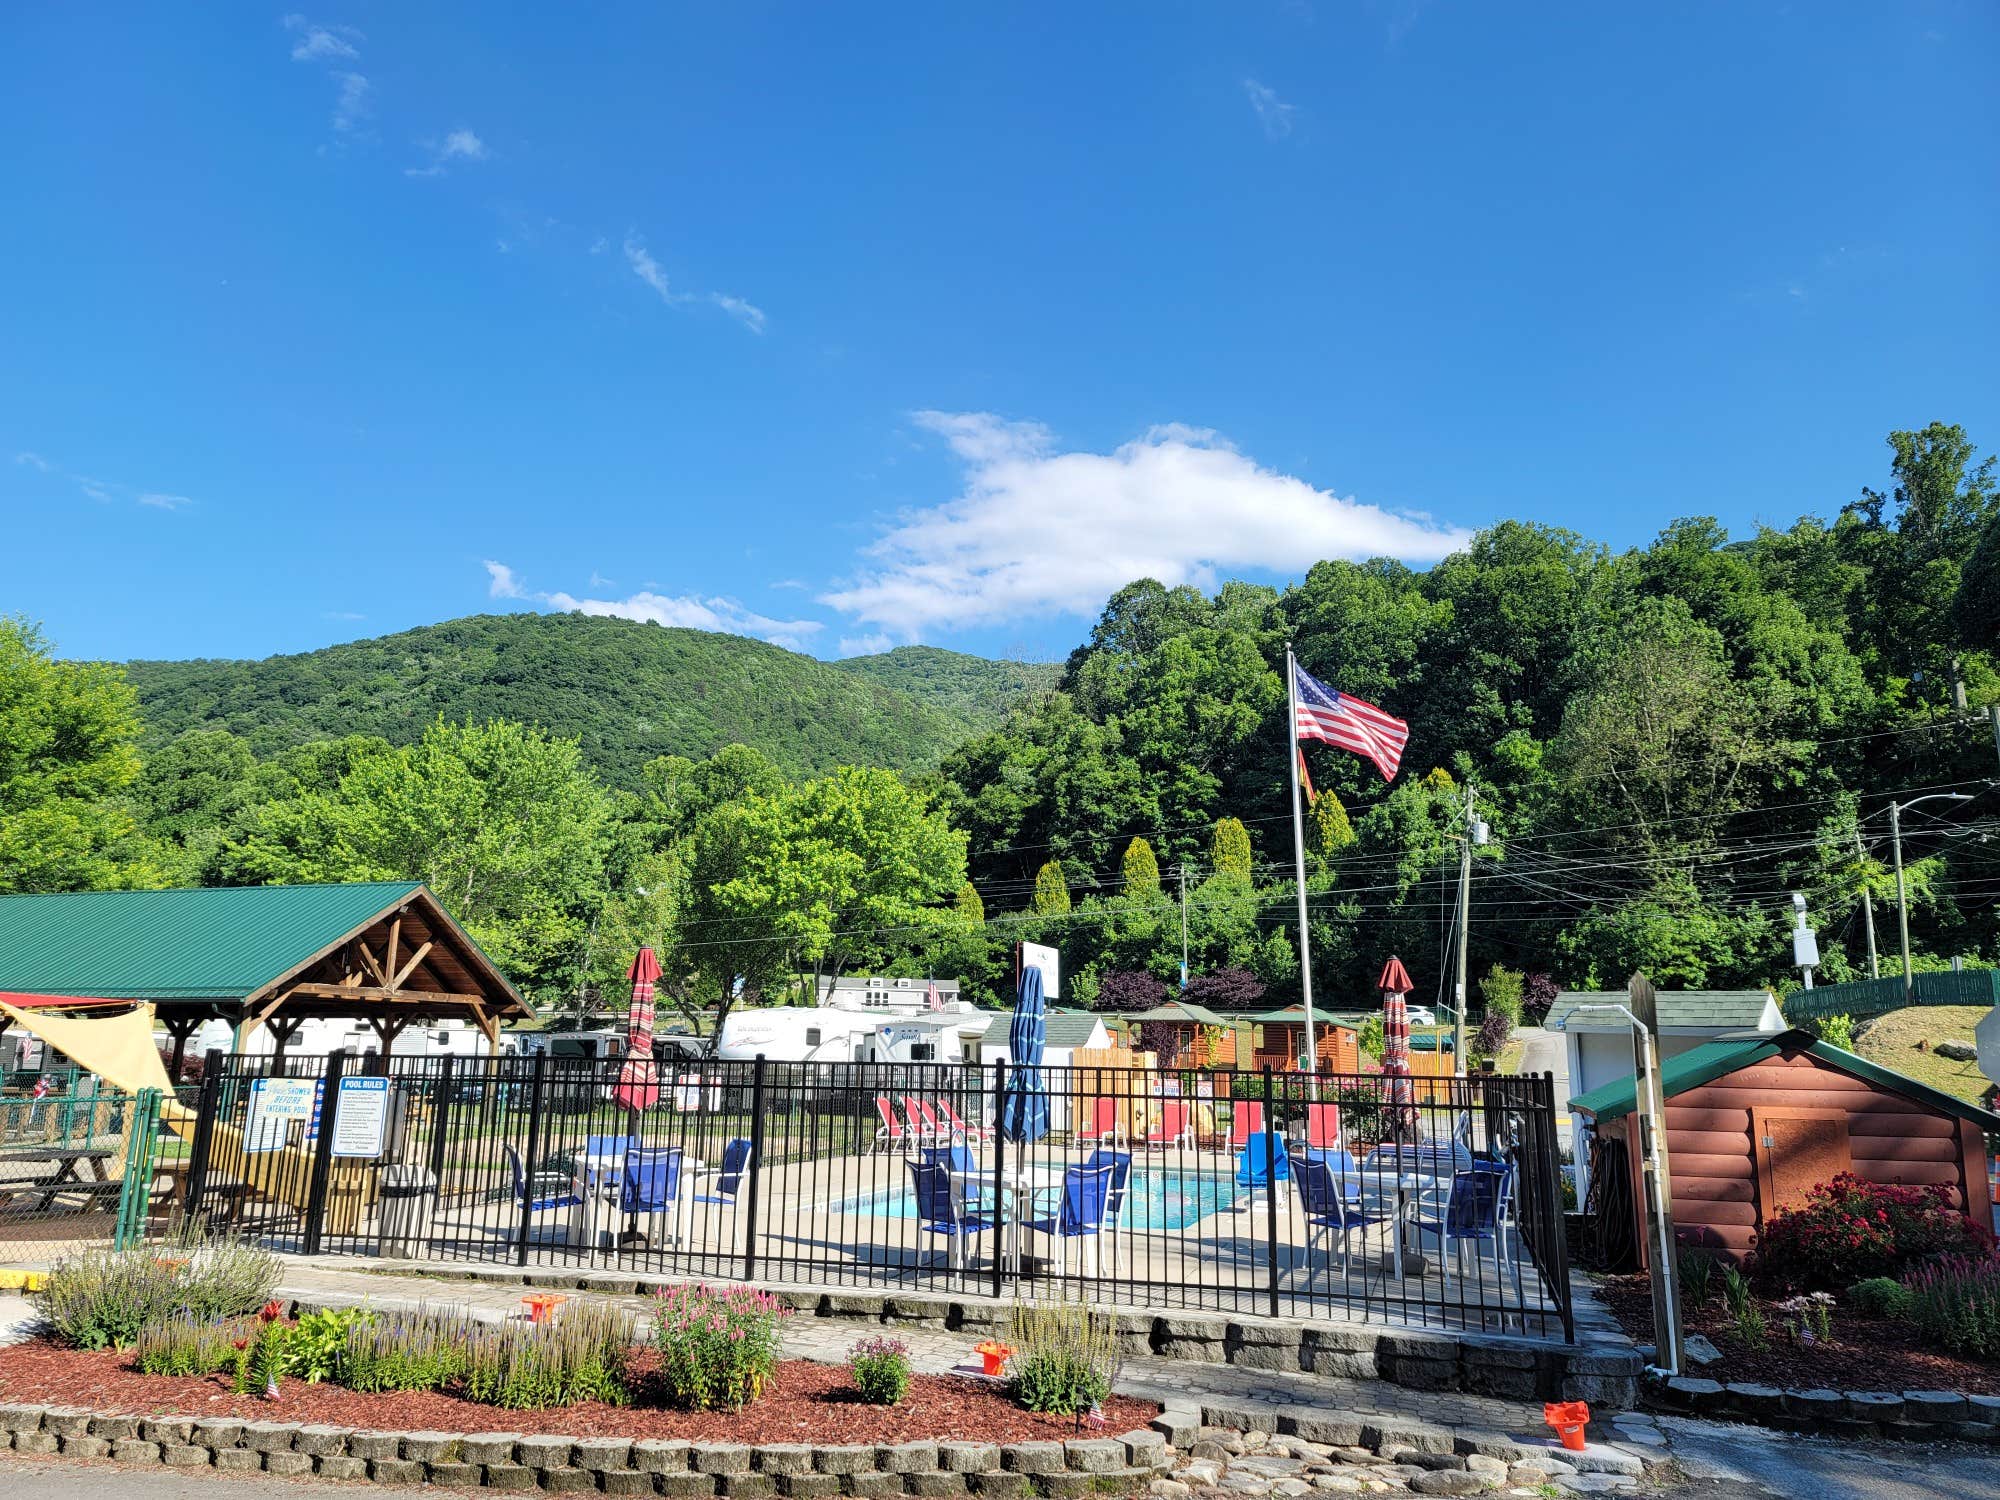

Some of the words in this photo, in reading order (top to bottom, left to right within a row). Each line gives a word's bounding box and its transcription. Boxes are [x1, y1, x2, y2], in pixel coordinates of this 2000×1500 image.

[345, 1080, 362, 1088] POOL
[363, 1080, 384, 1088] RULES
[288, 1088, 312, 1097] SHOWER
[274, 1096, 303, 1104] BEFORE
[265, 1105, 291, 1113] ENTERING
[293, 1106, 308, 1114] POOL
